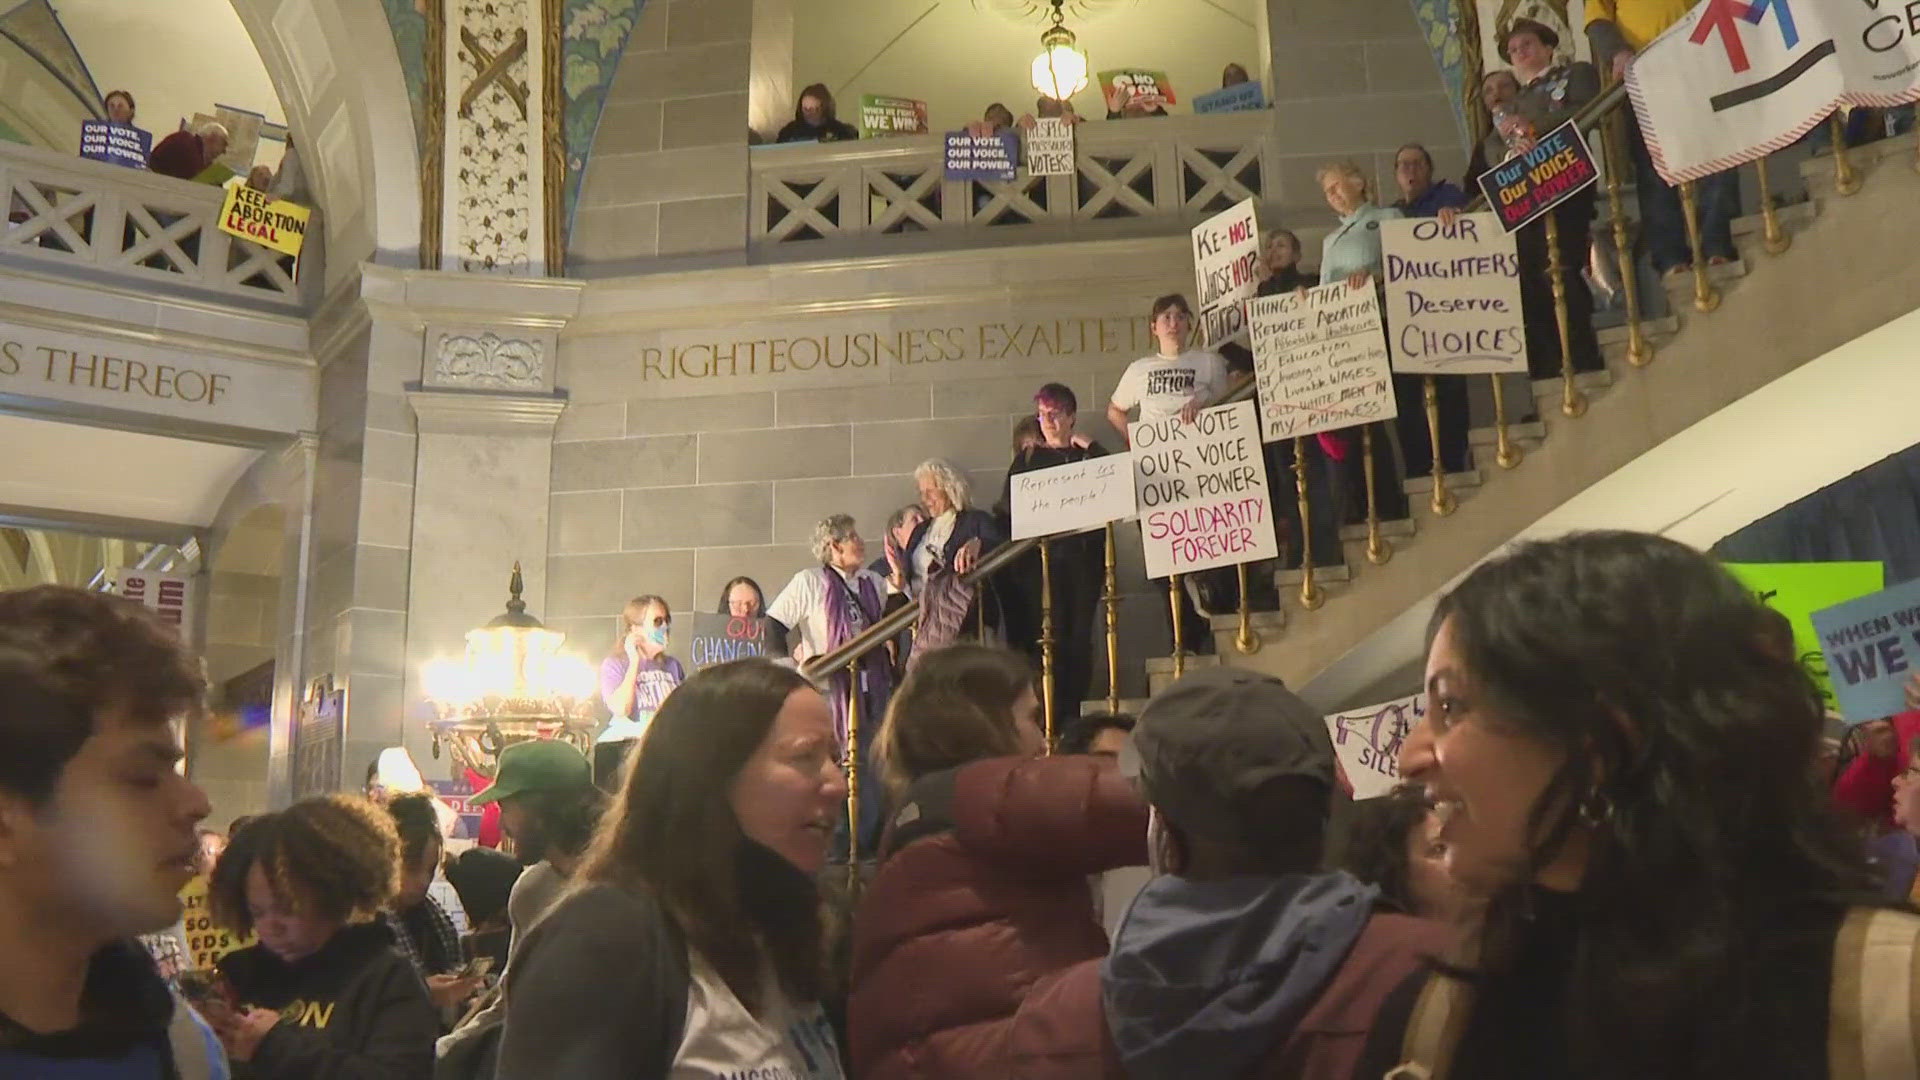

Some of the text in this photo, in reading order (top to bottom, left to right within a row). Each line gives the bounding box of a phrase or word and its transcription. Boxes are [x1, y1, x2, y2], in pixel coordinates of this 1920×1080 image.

[1133, 74, 1155, 85] NO
[1137, 84, 1160, 95] ON
[84, 124, 108, 133] OUR
[864, 115, 889, 129] WE
[82, 144, 106, 153] OUR
[83, 134, 107, 143] OUR
[948, 136, 1004, 146] OUR VOTE.
[948, 149, 1008, 158] OUR VOICE.
[1523, 134, 1567, 168] VOTE
[948, 160, 1014, 170] OUR POWER.
[1528, 146, 1579, 185] VOICE
[1532, 160, 1588, 204] POWER
[227, 214, 279, 243] LEGAL
[231, 202, 305, 234] ABORTION
[1197, 217, 1254, 260] KE-HOE
[1387, 252, 1520, 282] DAUGHTERS
[1250, 296, 1299, 318] THINGS
[1309, 284, 1348, 309] THAT
[1406, 291, 1510, 317] Deserve
[1253, 297, 1378, 340] REDUCE ABORTION
[641, 326, 965, 381] RIGHTEOUSNESS
[1401, 324, 1523, 358] CHOICES
[37, 346, 231, 406] THEREOF
[1136, 408, 1240, 448] OUR VOTE
[1270, 416, 1296, 436] MY
[1140, 437, 1249, 477] OUR VOICE
[1020, 468, 1087, 493] Represent
[1143, 466, 1261, 507] OUR POWER
[1031, 500, 1050, 513] the
[1148, 499, 1263, 540] SOLIDARITY
[1171, 528, 1257, 565] FOREVER
[1825, 615, 1892, 648] WHEN
[1832, 636, 1909, 686] WE
